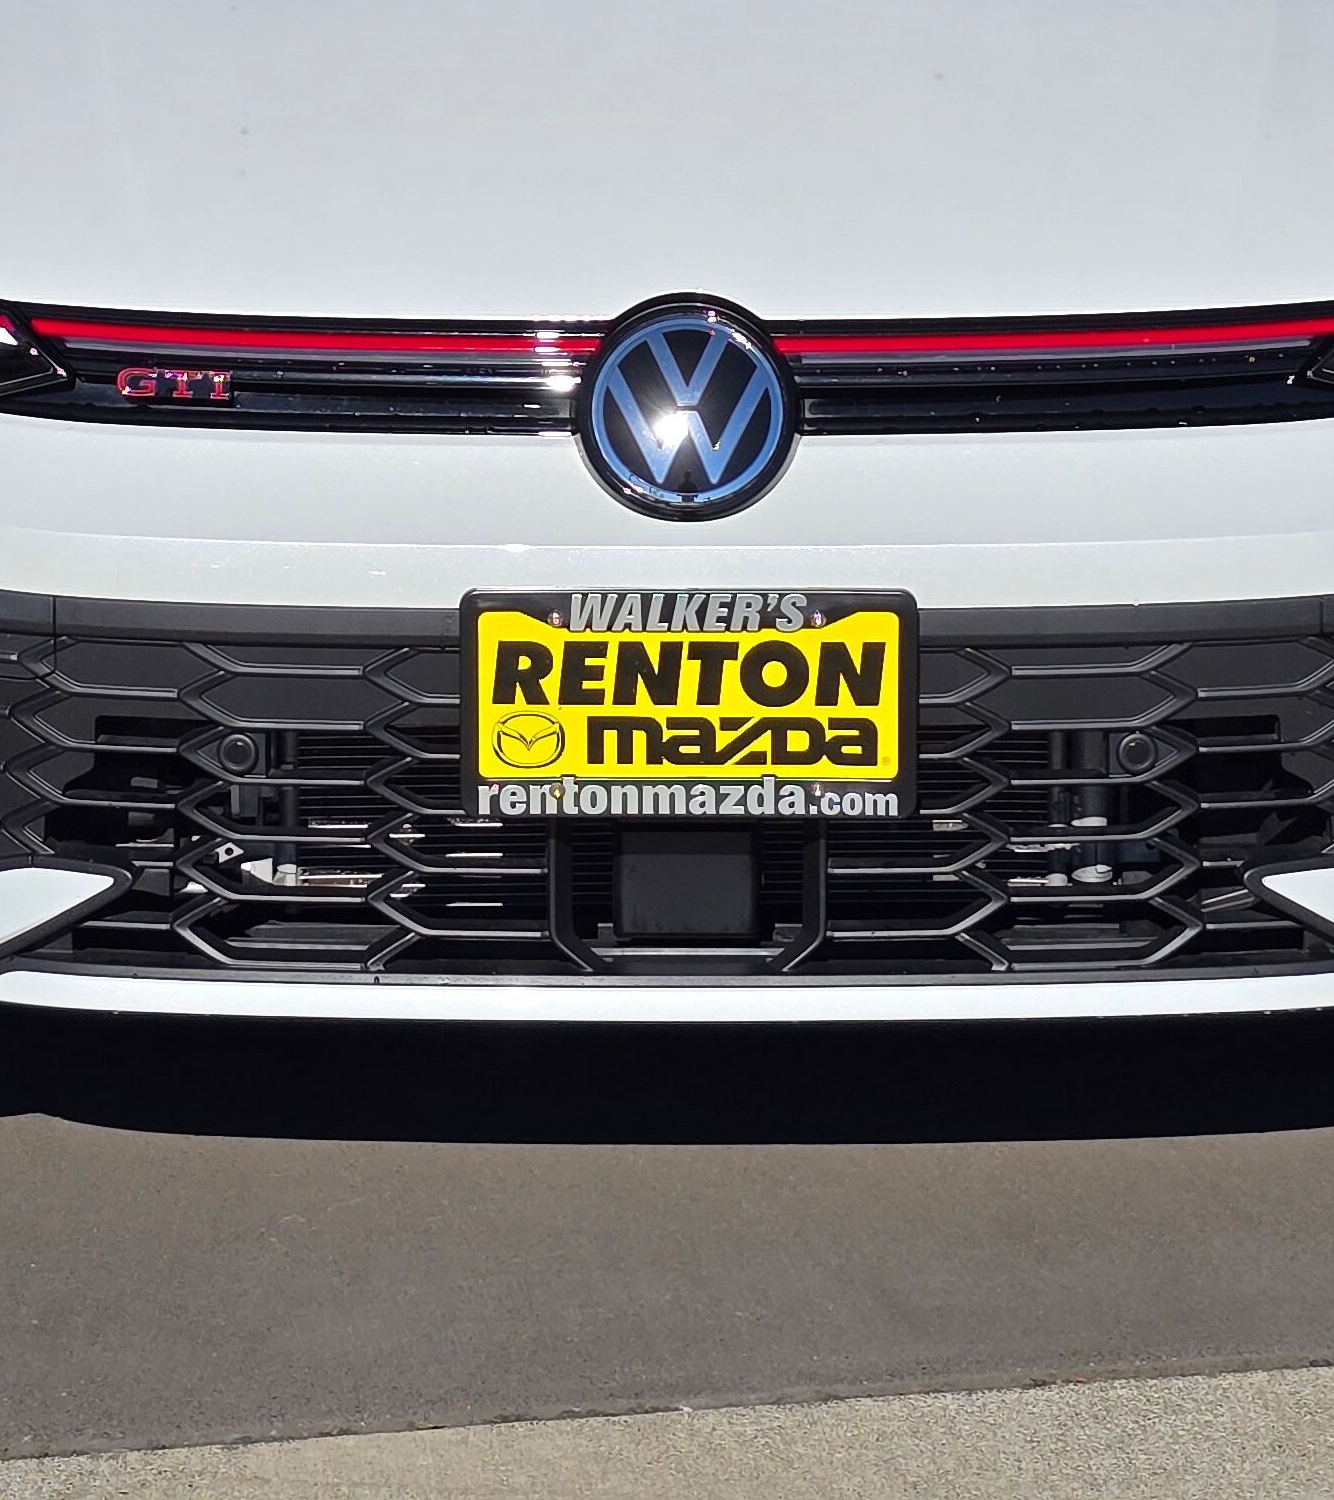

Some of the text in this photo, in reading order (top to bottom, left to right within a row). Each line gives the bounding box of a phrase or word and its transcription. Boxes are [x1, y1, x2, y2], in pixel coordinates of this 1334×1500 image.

[117, 367, 231, 399] GTI
[567, 593, 808, 633] WALKER'S
[491, 640, 887, 707] RENTON
[586, 716, 879, 766] mazda
[477, 776, 899, 817] rentonmazda.com
